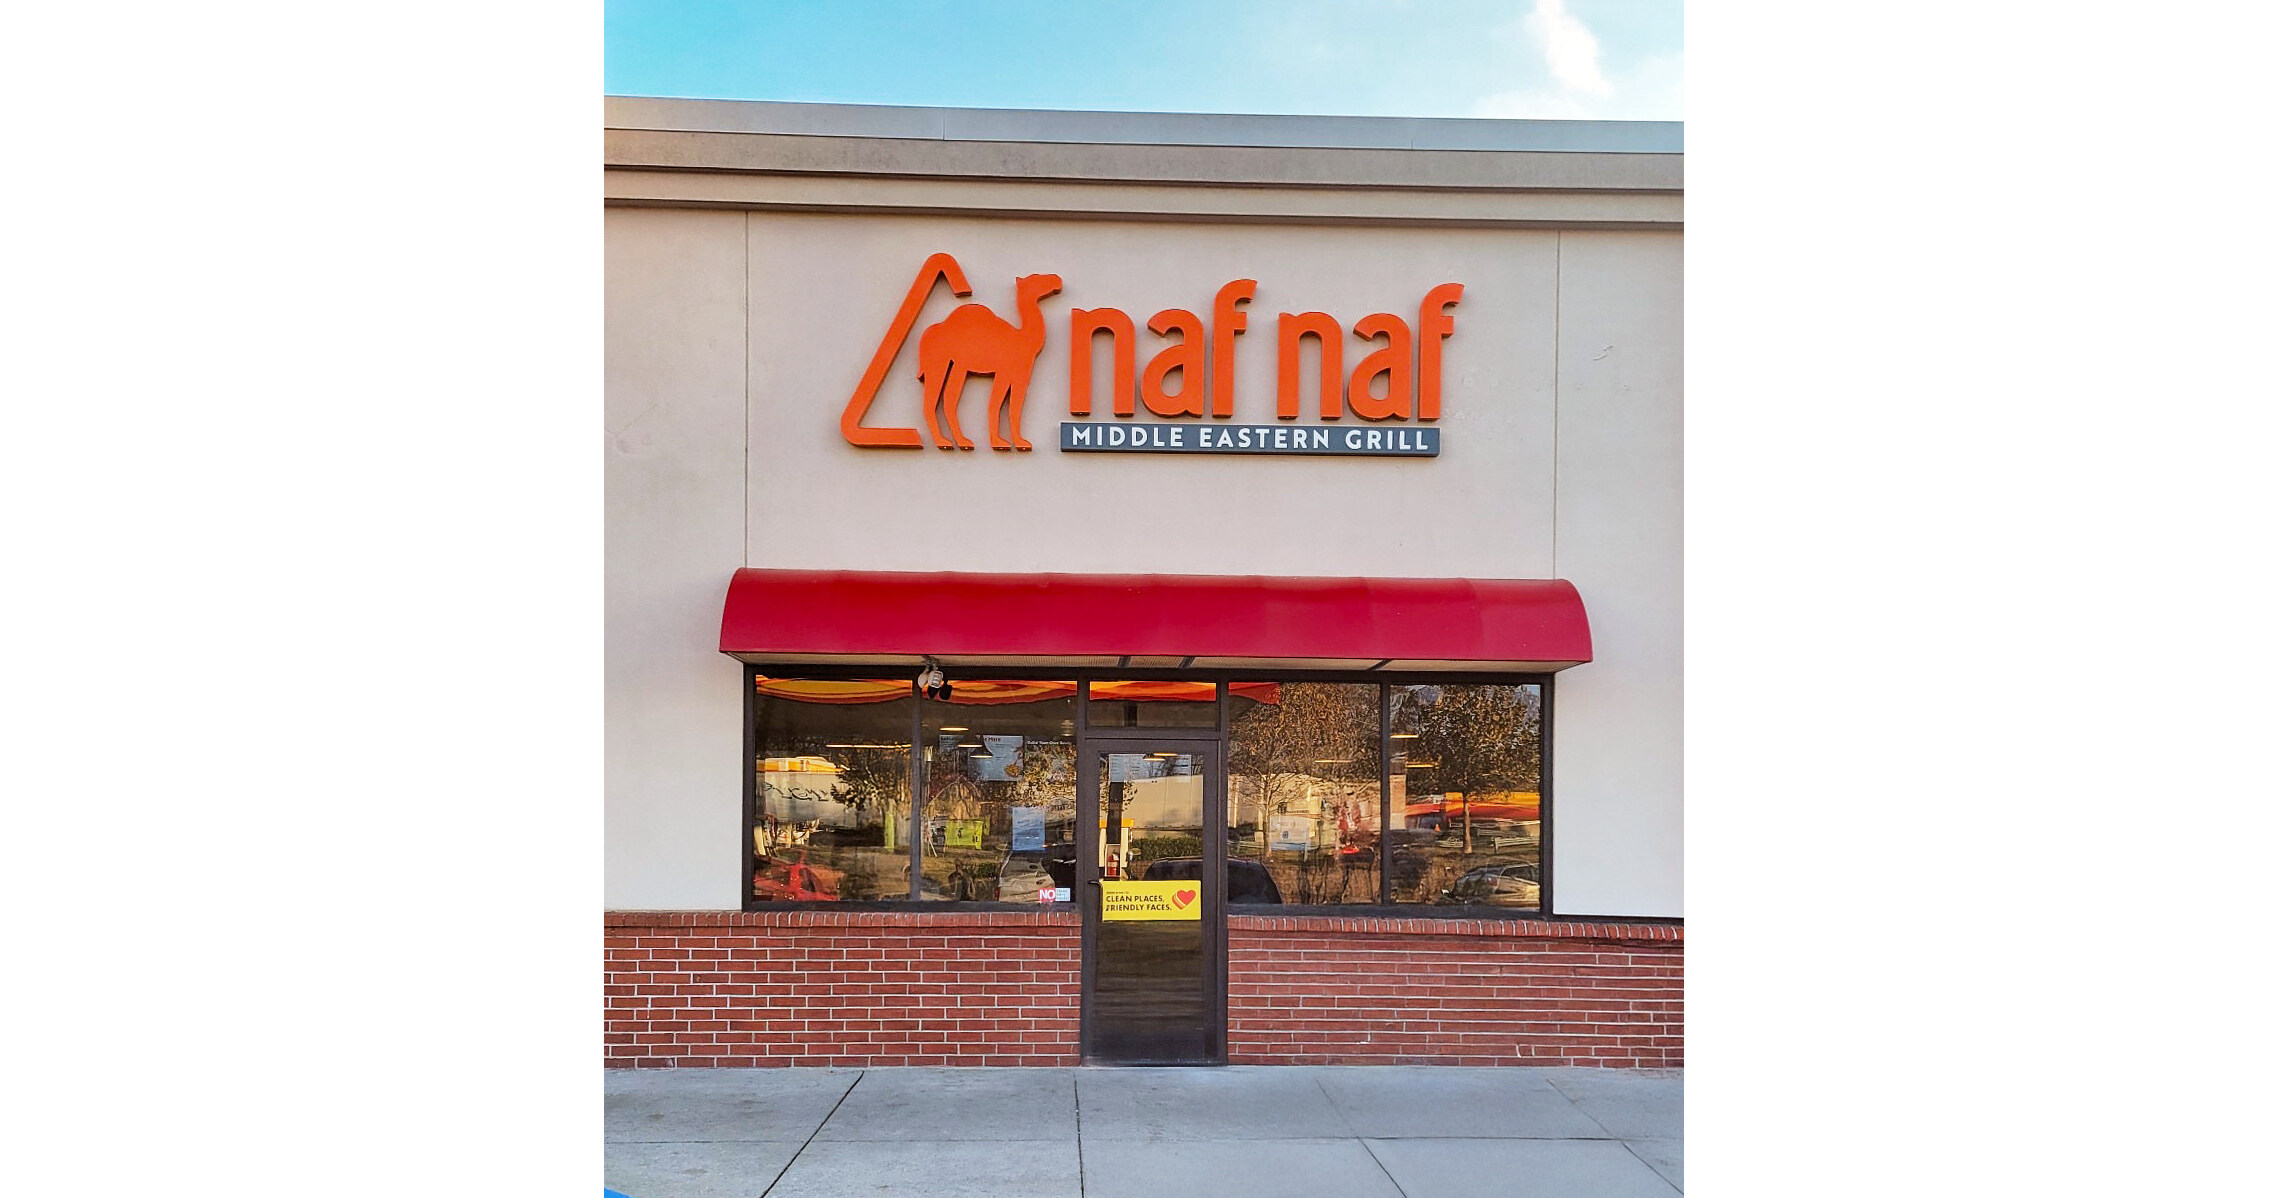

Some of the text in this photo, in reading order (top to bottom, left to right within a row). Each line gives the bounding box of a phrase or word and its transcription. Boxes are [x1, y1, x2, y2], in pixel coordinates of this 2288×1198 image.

[1069, 279, 1465, 422] naf naf
[1071, 426, 1429, 451] MIDDLE EASTERN GRILL
[1039, 889, 1056, 900] NO
[1105, 895, 1133, 903] CLEAN
